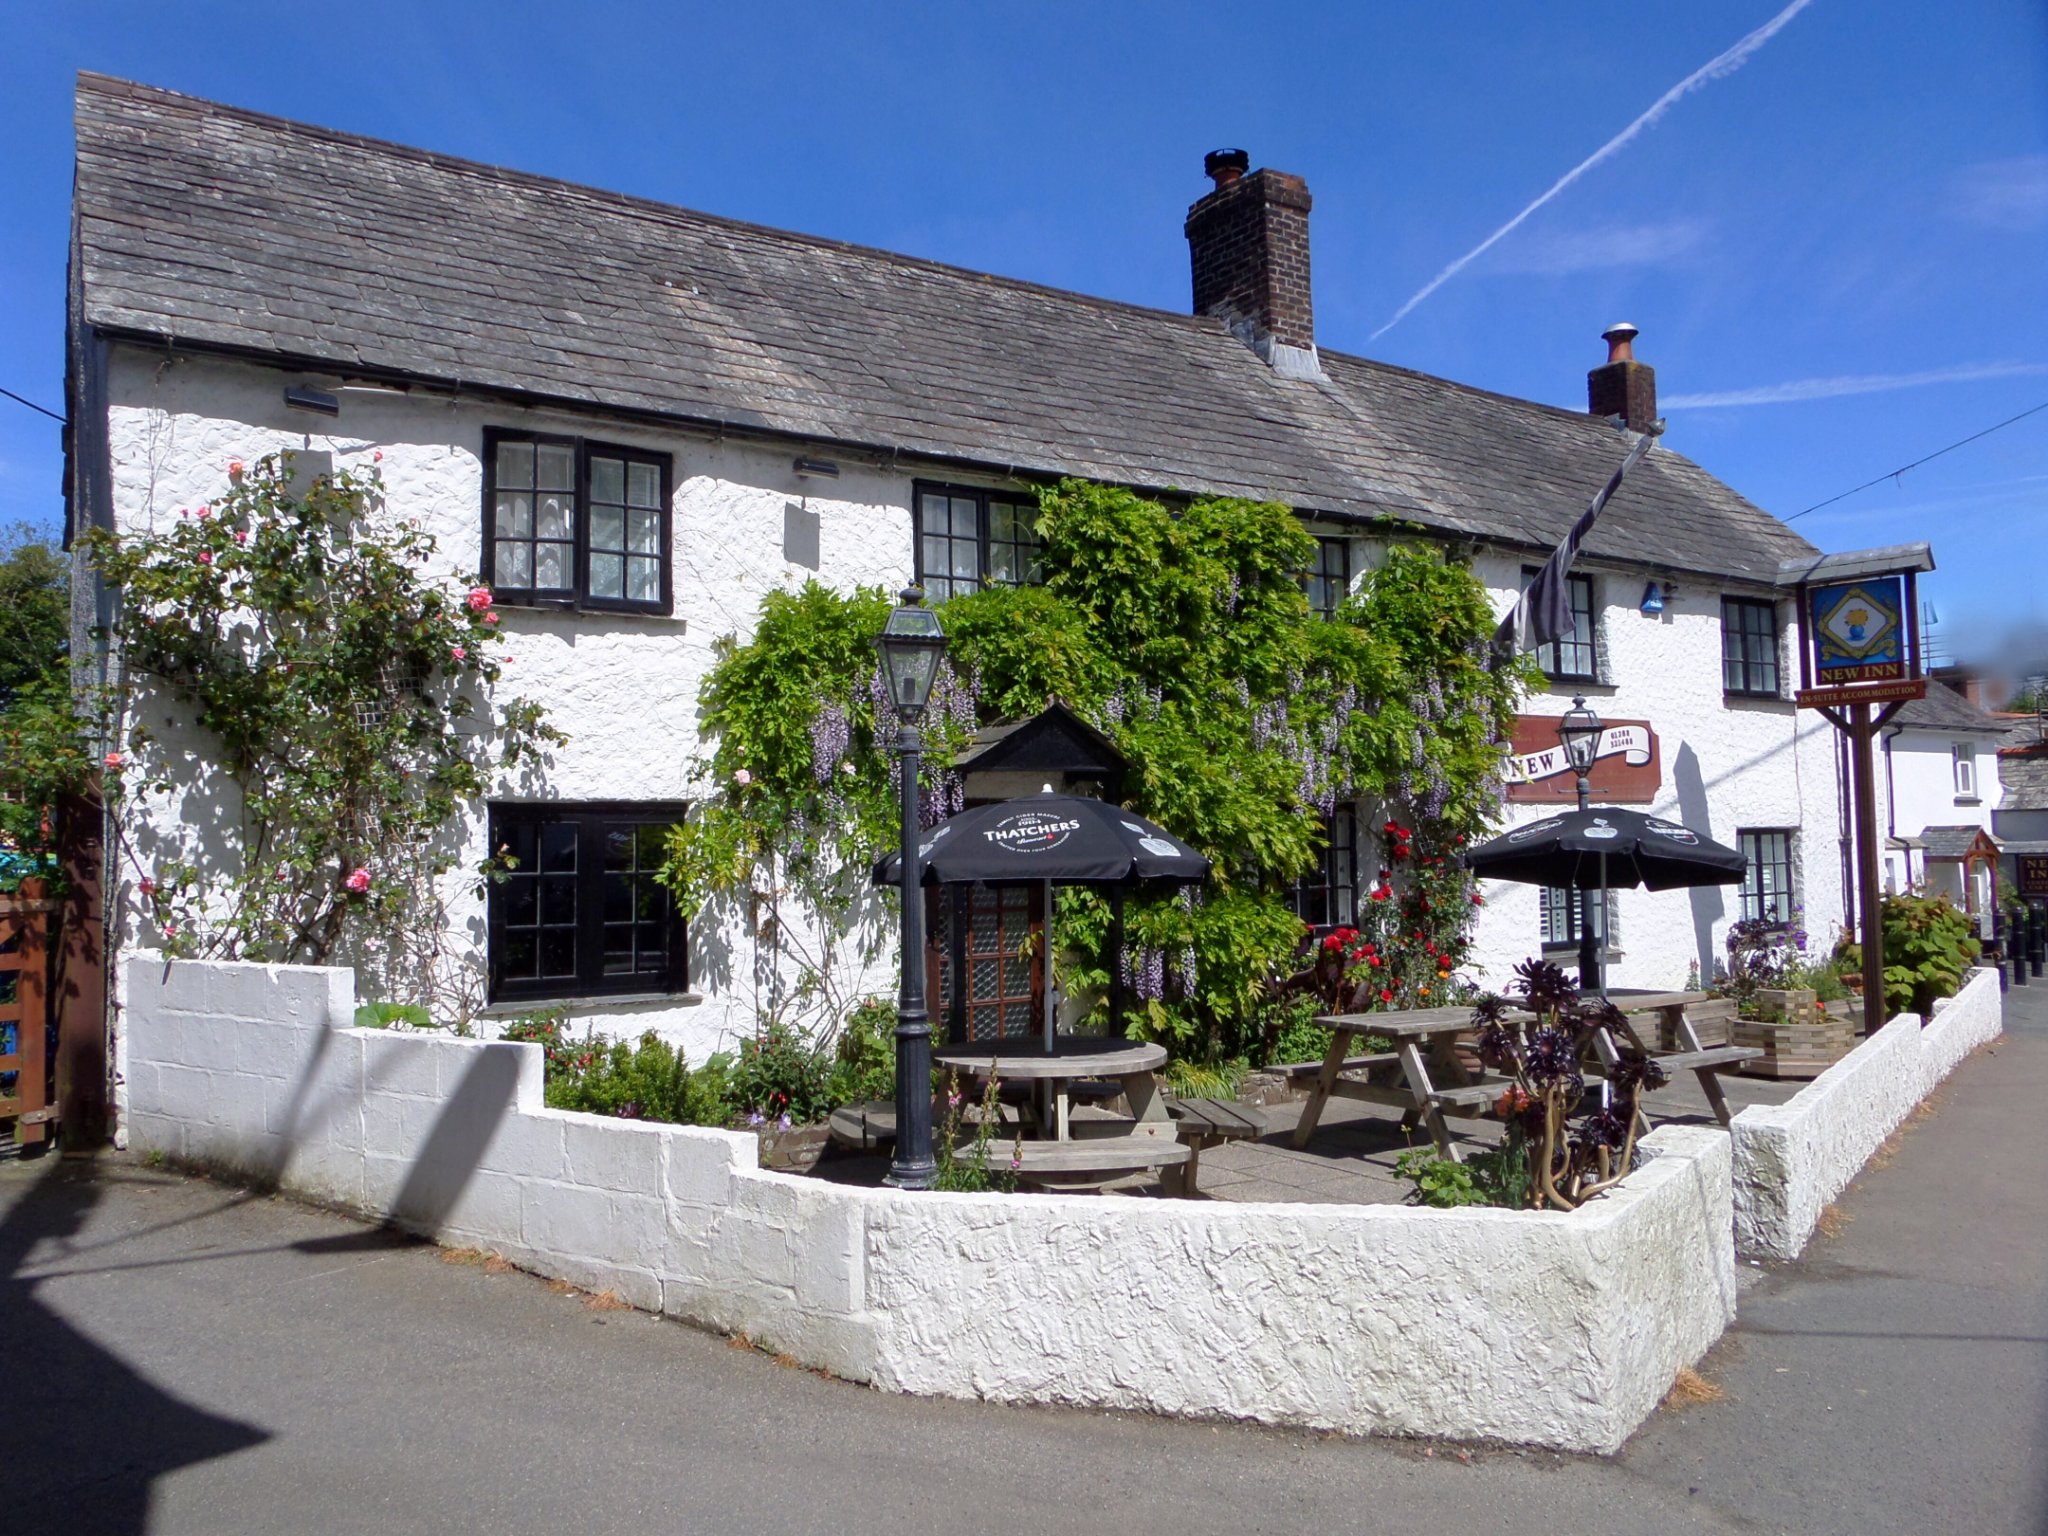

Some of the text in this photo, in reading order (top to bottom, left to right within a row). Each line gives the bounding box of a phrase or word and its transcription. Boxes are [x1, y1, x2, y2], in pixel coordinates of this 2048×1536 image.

[1821, 664, 1898, 681] NEW INN
[1800, 686, 1917, 703] EN-SUITE ACCOMMODATION
[1510, 752, 1554, 777] NEW
[983, 819, 1080, 842] THATCHERS
[2027, 859, 2048, 869] NE
[2030, 869, 2047, 879] IN
